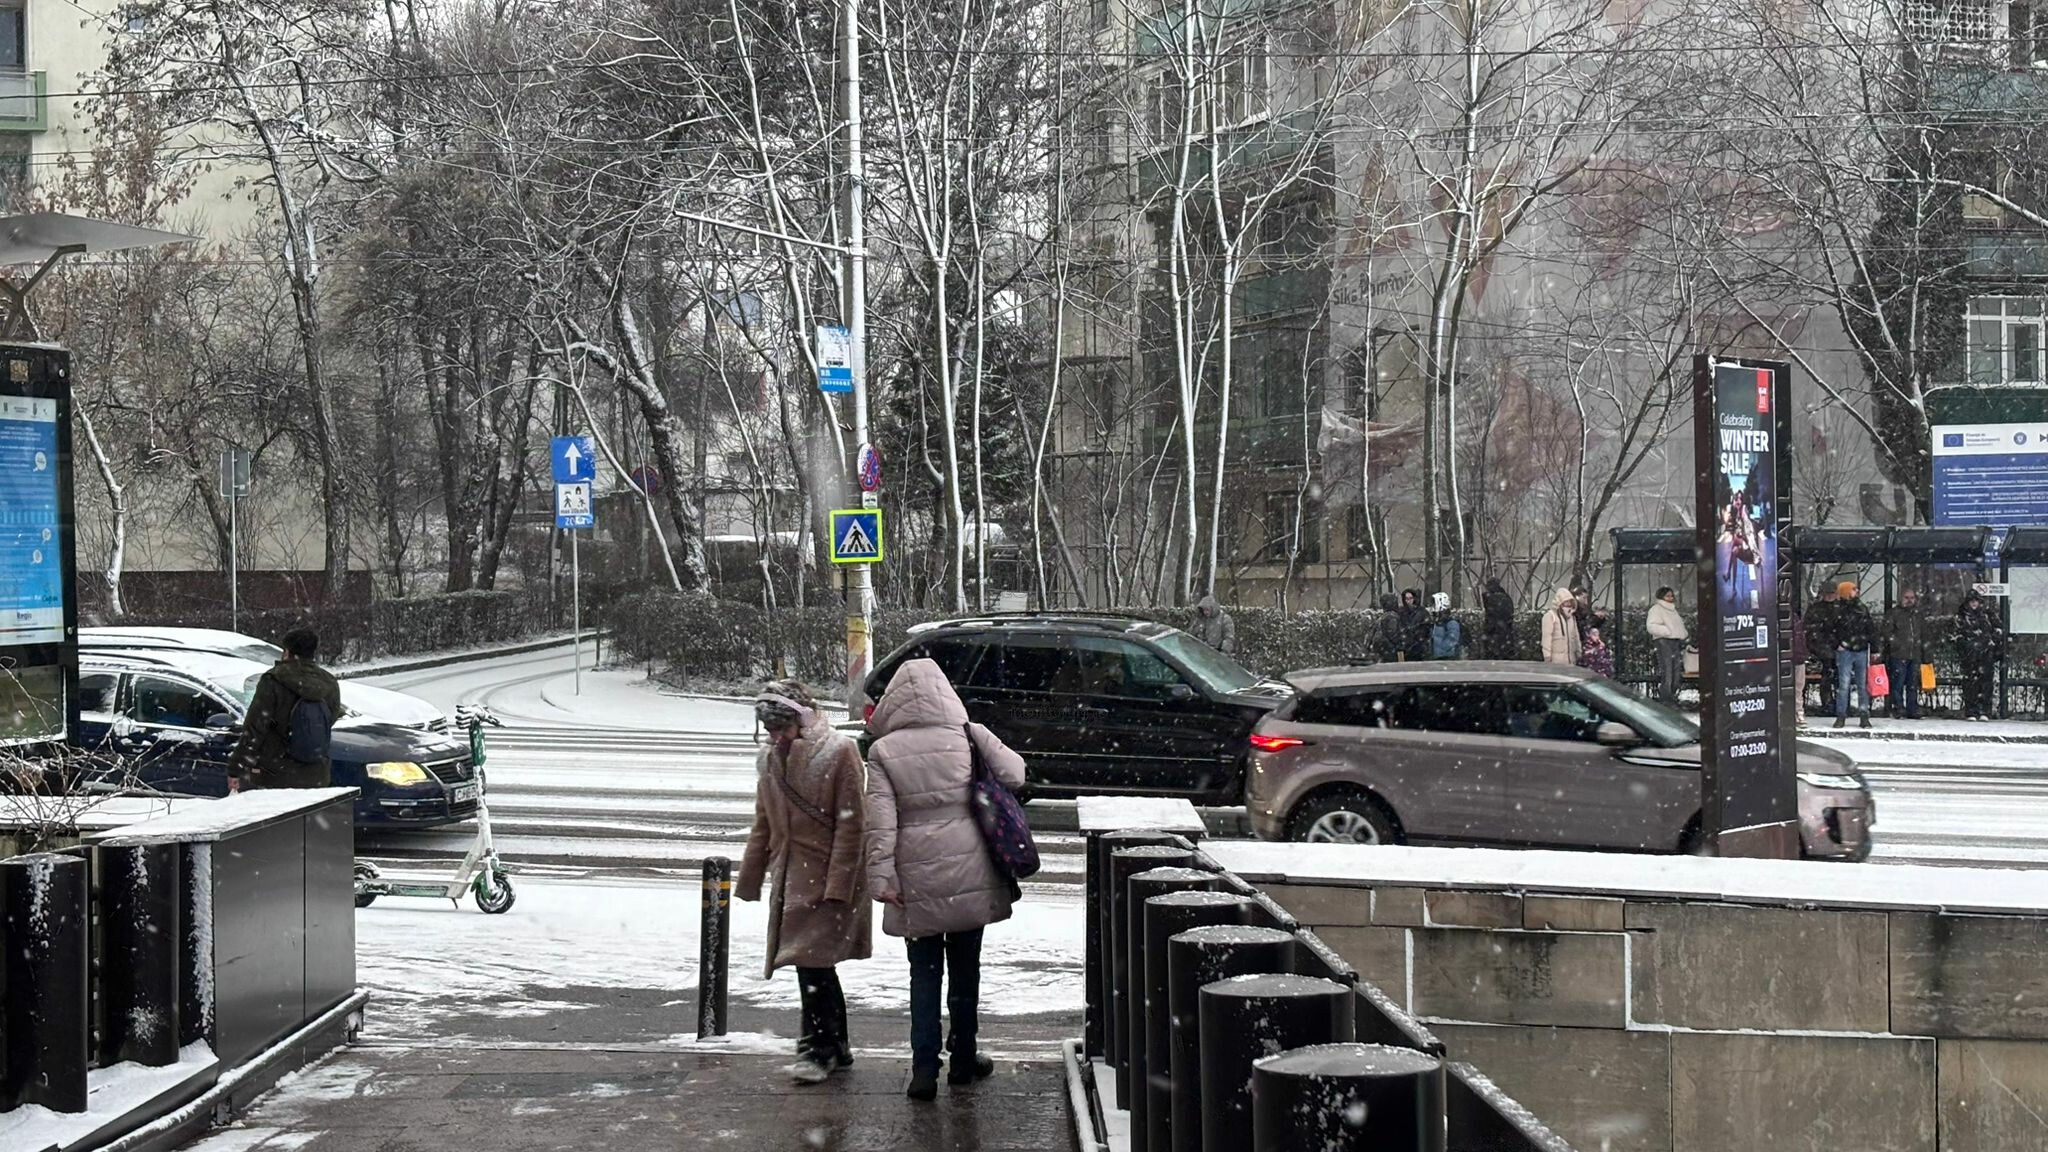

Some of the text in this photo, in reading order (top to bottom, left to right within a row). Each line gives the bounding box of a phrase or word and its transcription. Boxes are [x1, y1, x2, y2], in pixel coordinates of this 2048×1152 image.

[1720, 413, 1754, 429] Celebrating
[1720, 429, 1769, 452] WINTER
[1720, 453, 1750, 474] SALE
[1737, 614, 1754, 630] 70%
[1730, 698, 1765, 714] 10:00-22:00
[1730, 742, 1766, 758] 07:00-23:00
